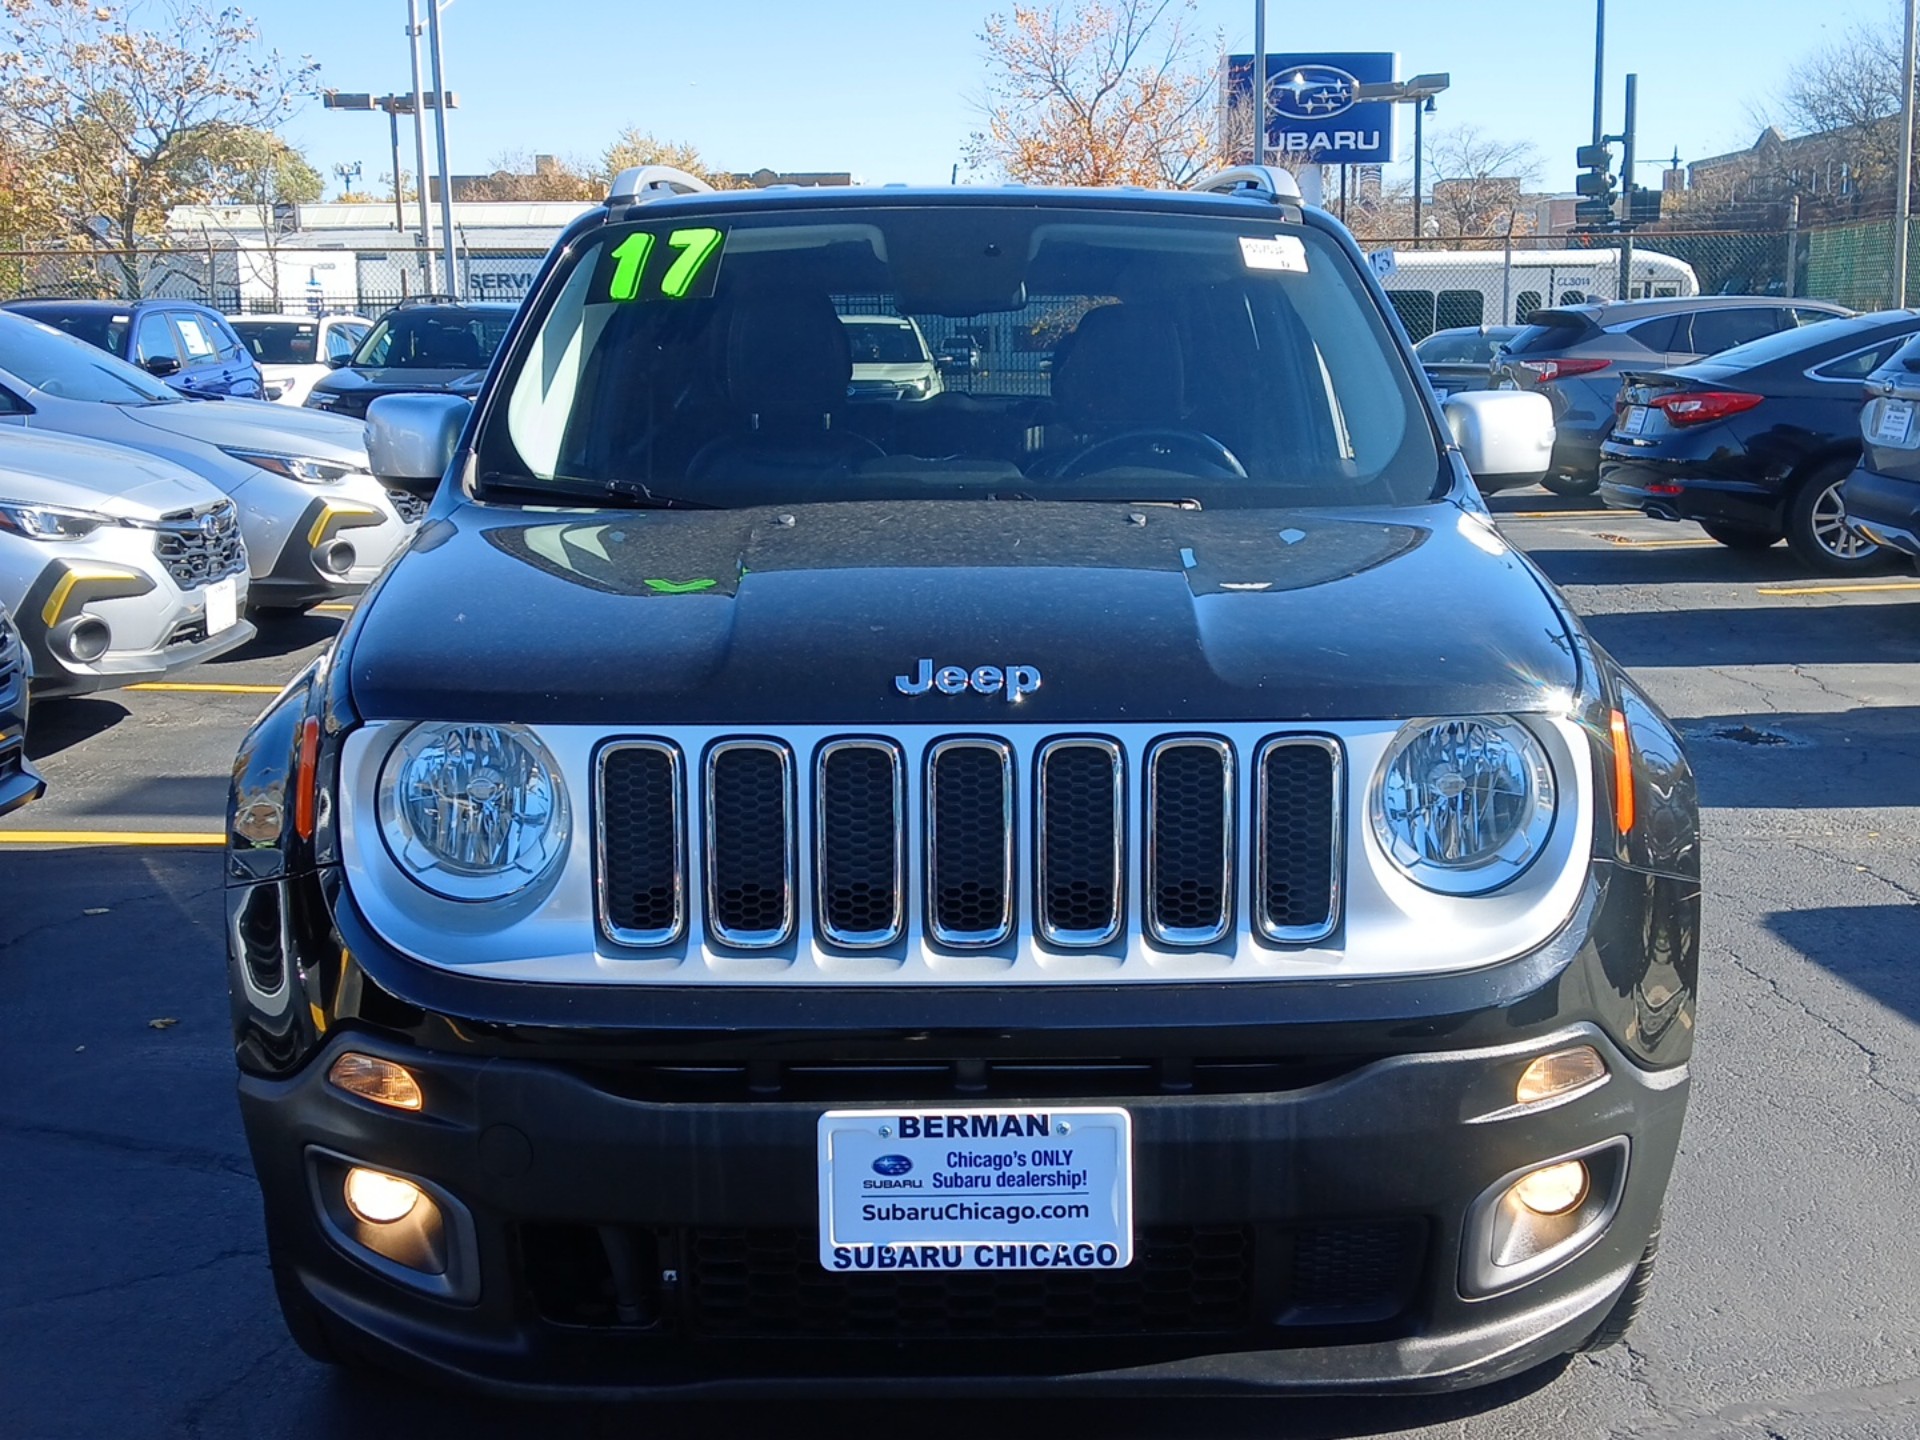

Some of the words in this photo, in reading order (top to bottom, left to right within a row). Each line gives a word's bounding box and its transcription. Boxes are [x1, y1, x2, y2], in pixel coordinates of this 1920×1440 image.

[1262, 130, 1380, 151] UBARU
[609, 228, 722, 301] 17
[895, 658, 1042, 702] Jeep
[898, 1114, 1050, 1139] BERMAN
[946, 1151, 1026, 1170] Chicago's
[1031, 1150, 1074, 1166] ONLY
[863, 1179, 923, 1189] SUBARU
[932, 1172, 992, 1189] Subaru
[996, 1170, 1088, 1190] dealership!
[862, 1201, 1090, 1224] SubaruChicago.com
[833, 1245, 963, 1269] SUBARU
[974, 1244, 1118, 1267] CHICAGO
